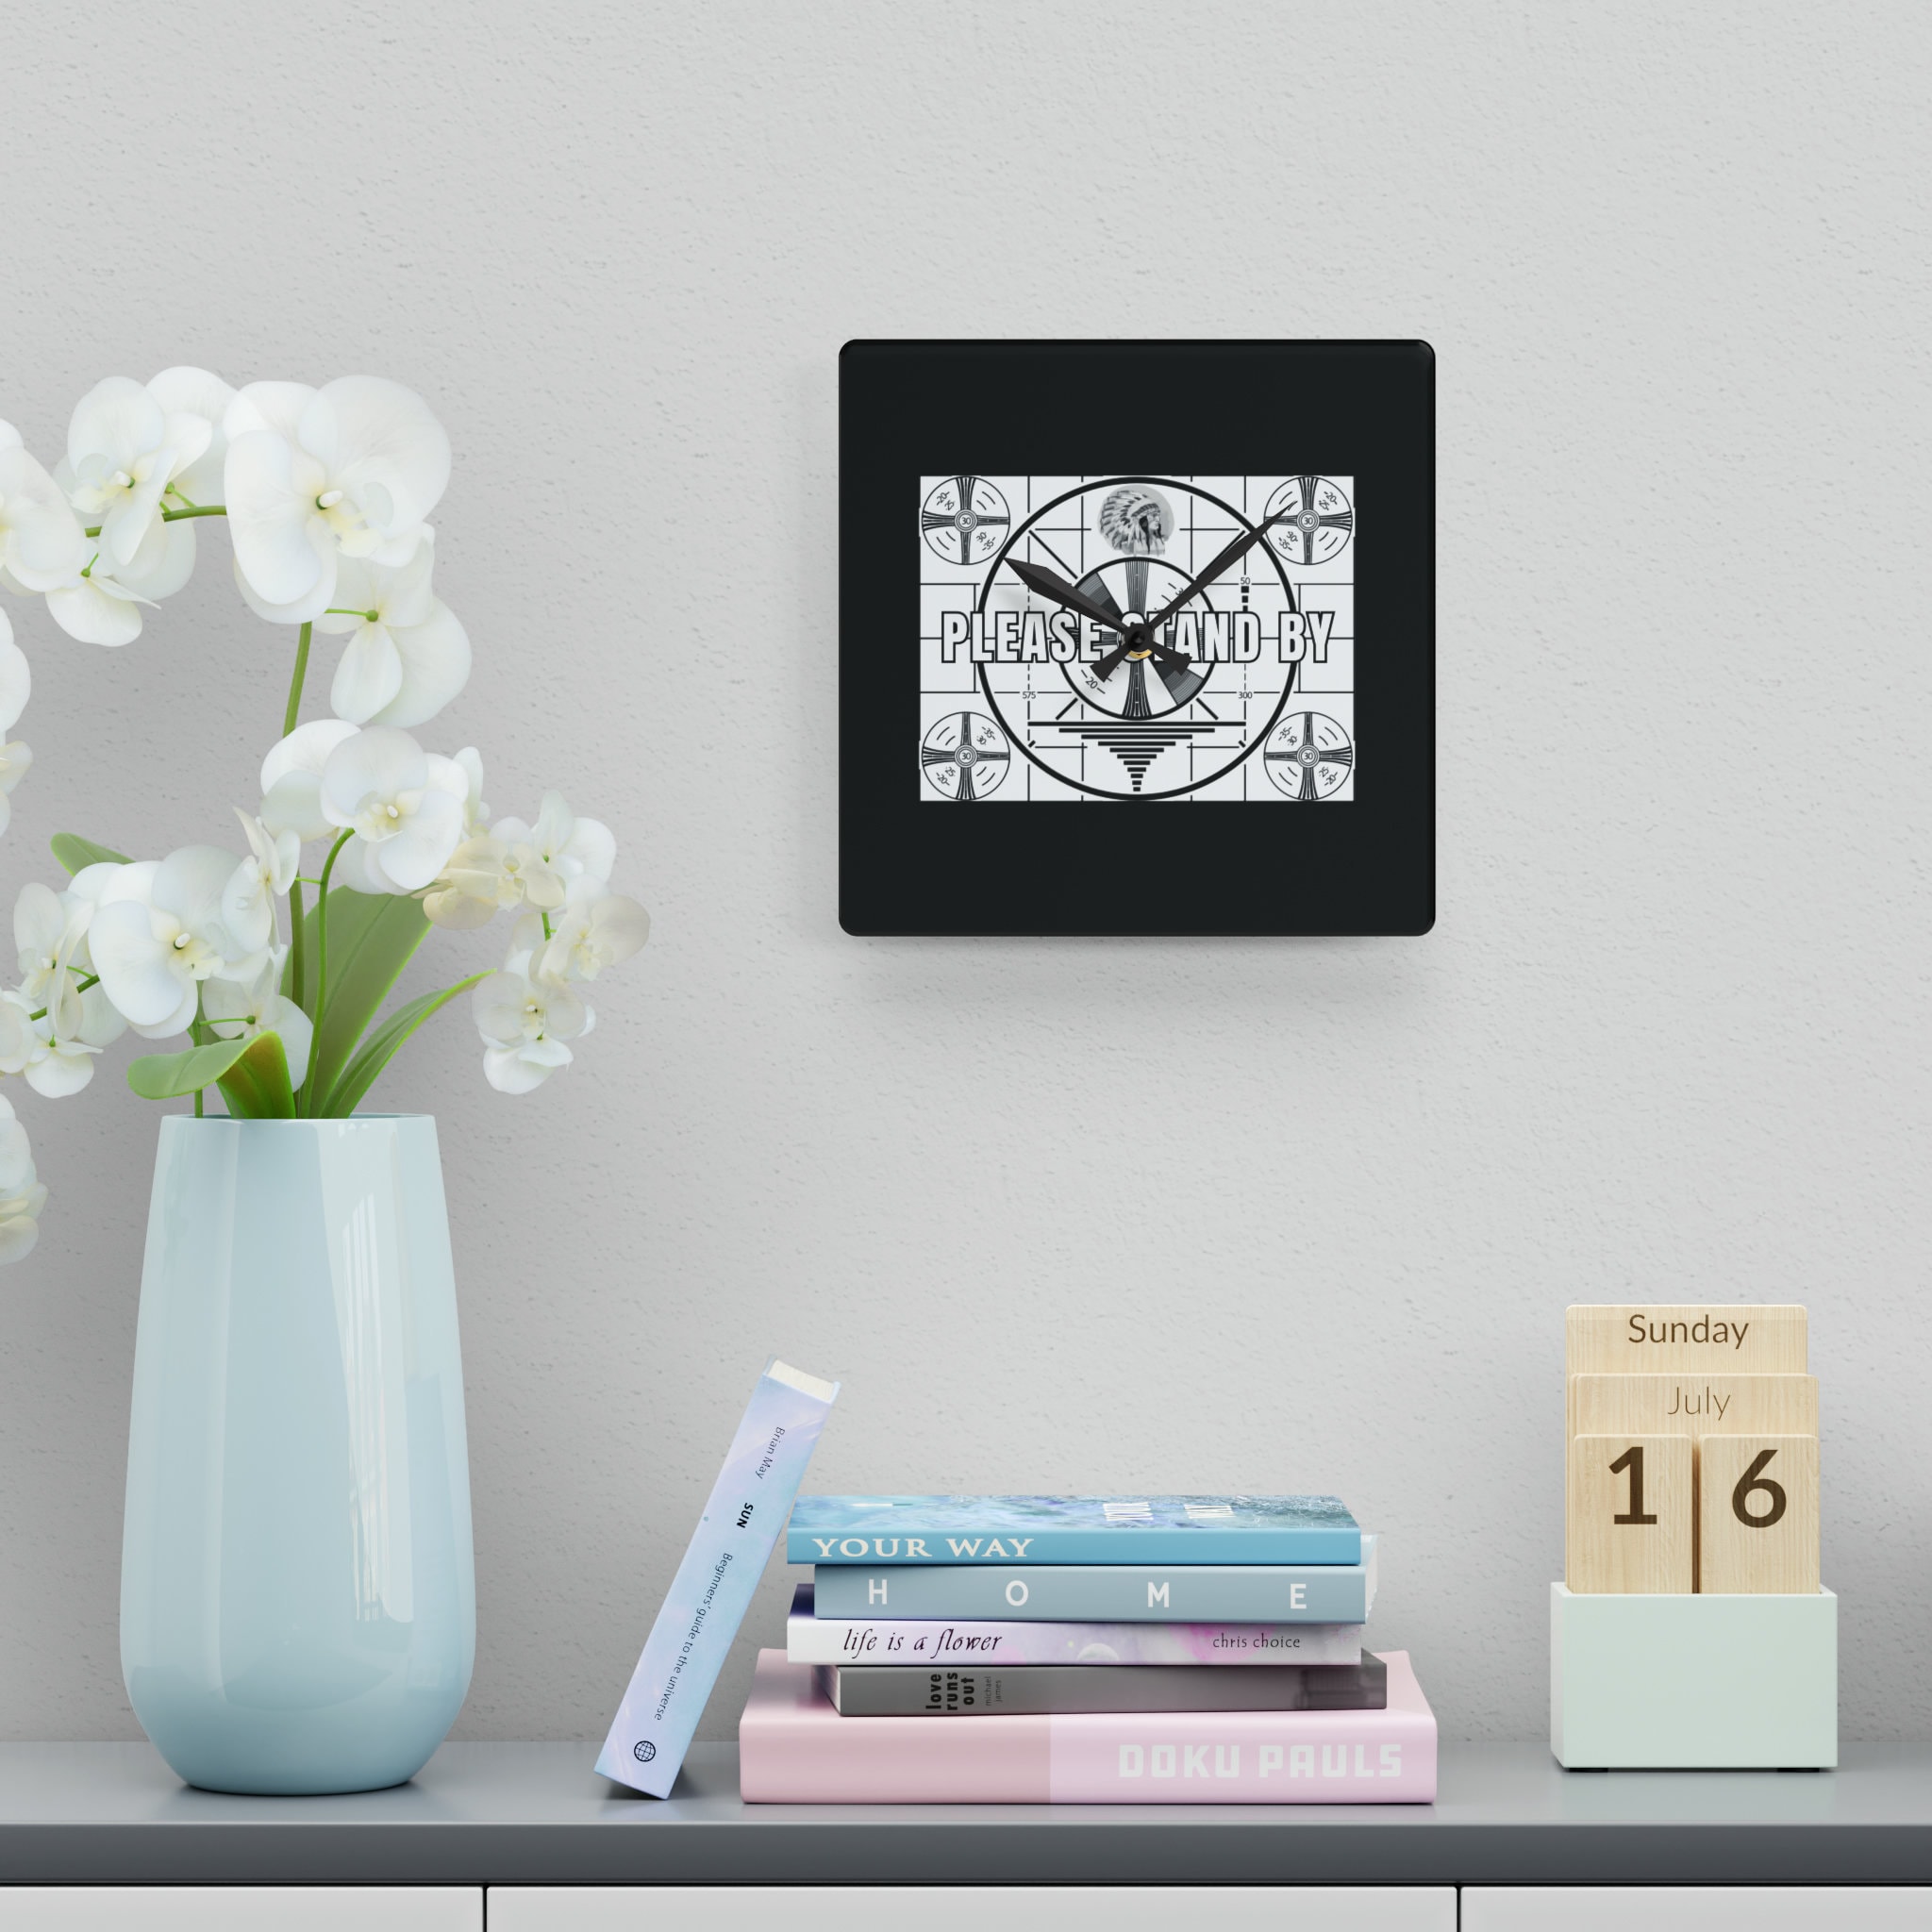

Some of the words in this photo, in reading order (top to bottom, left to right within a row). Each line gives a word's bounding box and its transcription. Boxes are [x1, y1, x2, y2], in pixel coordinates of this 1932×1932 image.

[941, 611, 1104, 664] PLEASE
[1278, 611, 1336, 664] BY
[1627, 1314, 1750, 1350] Sunday
[1667, 1387, 1732, 1421] July
[767, 1426, 786, 1455] Brian
[756, 1457, 773, 1479] May
[737, 1503, 754, 1528] SUN
[812, 1538, 933, 1557] YOUR
[946, 1538, 1035, 1557] WAY
[703, 1553, 733, 1609] Beginners'
[689, 1607, 707, 1640] guide
[682, 1641, 693, 1653] to
[843, 1629, 877, 1658] life
[888, 1632, 904, 1651] is
[913, 1637, 928, 1651] a
[930, 1629, 1003, 1658] flower
[1213, 1633, 1247, 1648] chris
[1253, 1633, 1301, 1648] choice
[674, 1656, 688, 1674] the
[655, 1676, 678, 1721] universe
[925, 1674, 941, 1709] love
[947, 1673, 958, 1710] runs
[960, 1677, 974, 1706] out
[984, 1676, 992, 1707] michael
[1119, 1745, 1241, 1778] DOKU
[1258, 1744, 1402, 1778] PAULS
